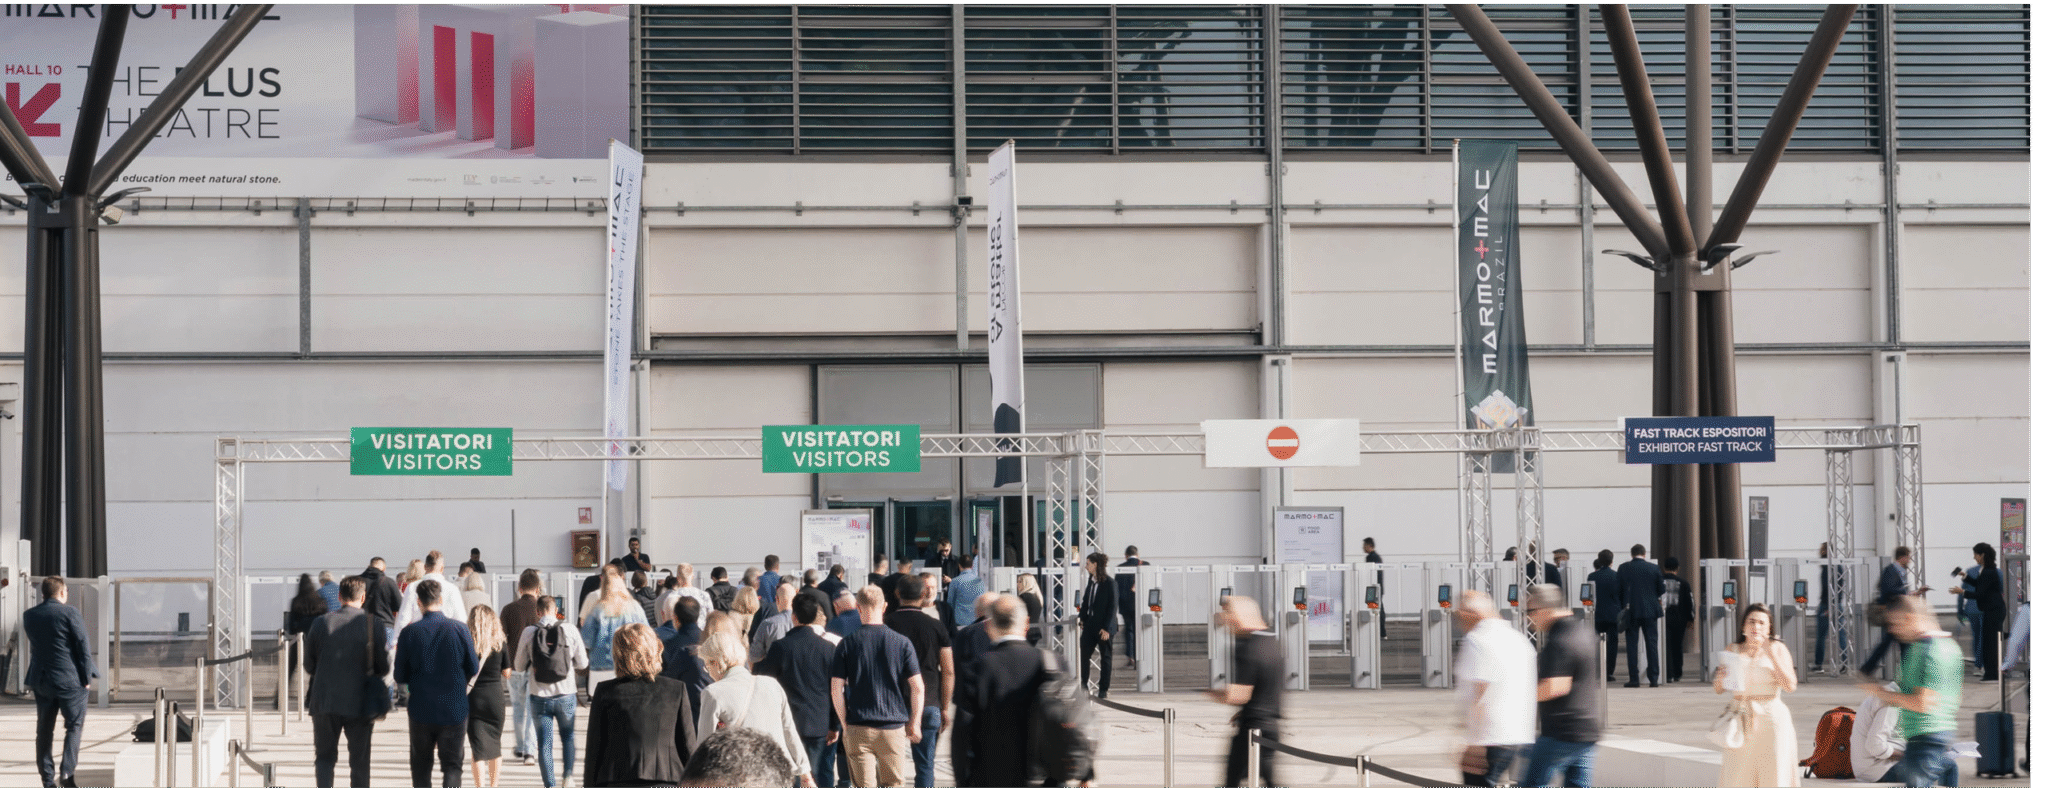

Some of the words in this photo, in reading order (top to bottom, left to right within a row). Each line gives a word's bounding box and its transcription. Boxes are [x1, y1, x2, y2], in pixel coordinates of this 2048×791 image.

[5, 64, 43, 75] HALL
[48, 65, 62, 76] 10
[175, 67, 281, 98] LUS
[77, 107, 280, 139] HATRE
[123, 174, 176, 183] education
[178, 175, 205, 184] meet
[209, 174, 246, 184] natural
[249, 174, 281, 184] stone.
[619, 231, 627, 262] THE
[1474, 169, 1497, 374] MARMO+MAC
[370, 433, 492, 450] VISITATORI
[781, 430, 900, 447] VISITATORI
[1634, 428, 1660, 439] FAST
[1663, 428, 1700, 438] TRACK
[1702, 427, 1766, 438] ESPOSITORI
[1638, 442, 1695, 453] EXHIBITOR
[1697, 441, 1724, 452] FAST
[1726, 441, 1762, 452] TRACK
[382, 453, 482, 470] VISITORS
[792, 450, 890, 467] VISITORS
